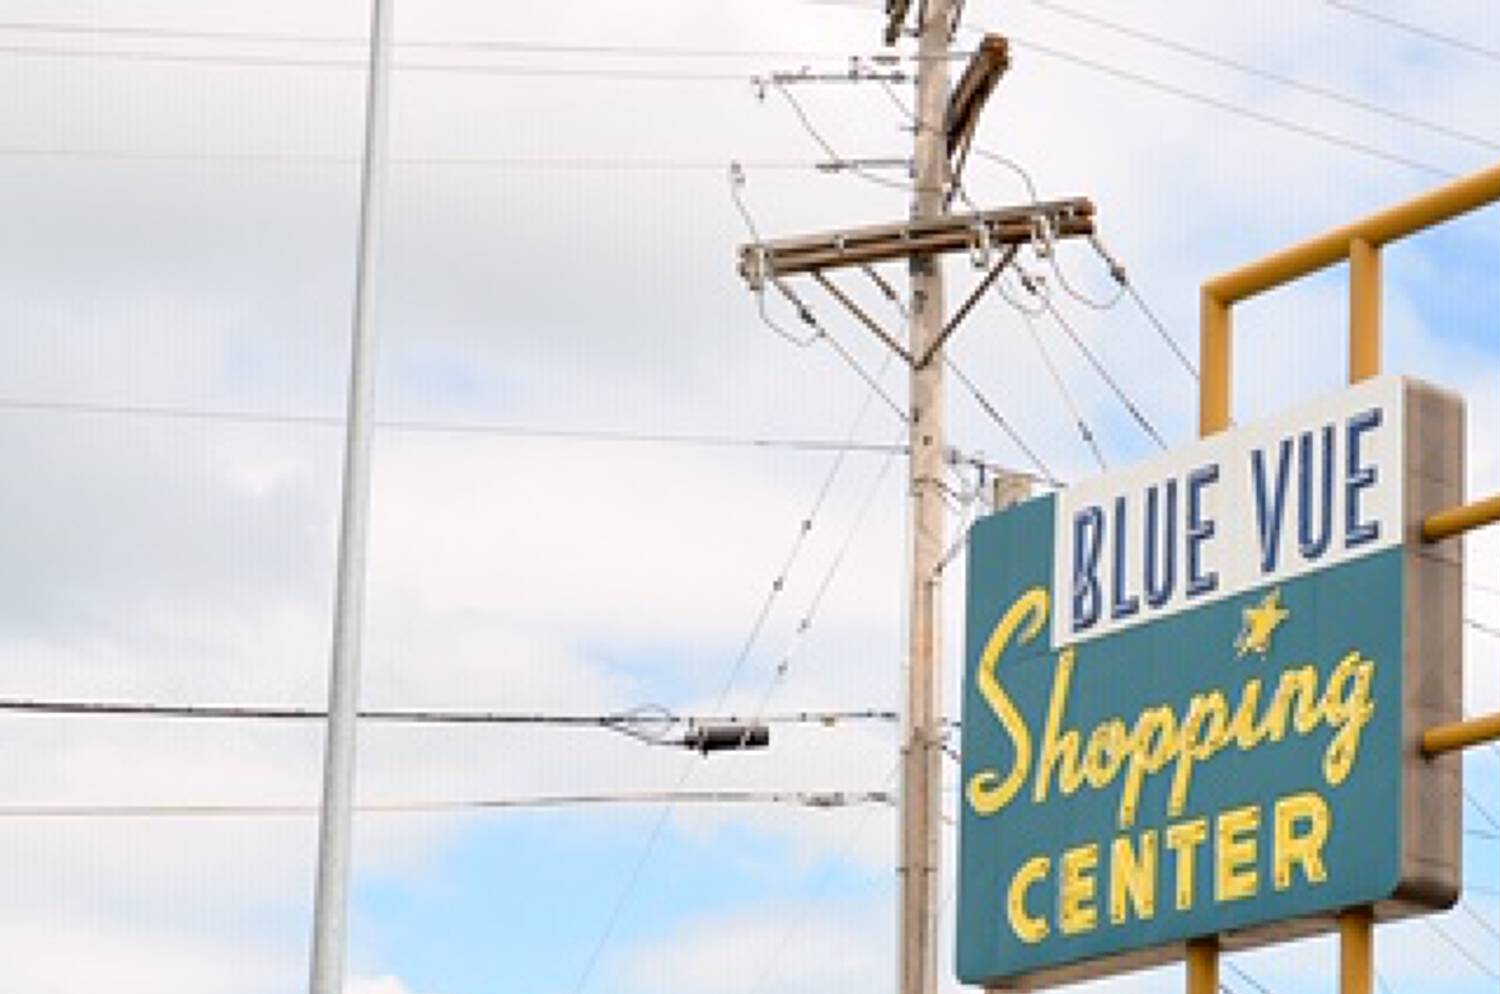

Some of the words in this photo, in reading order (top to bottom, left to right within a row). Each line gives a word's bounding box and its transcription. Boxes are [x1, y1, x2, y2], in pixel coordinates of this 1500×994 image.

[1071, 462, 1220, 634] BLUE
[1250, 406, 1384, 575] VUE
[967, 584, 1376, 827] Shopping
[1006, 791, 1332, 944] CENTER
